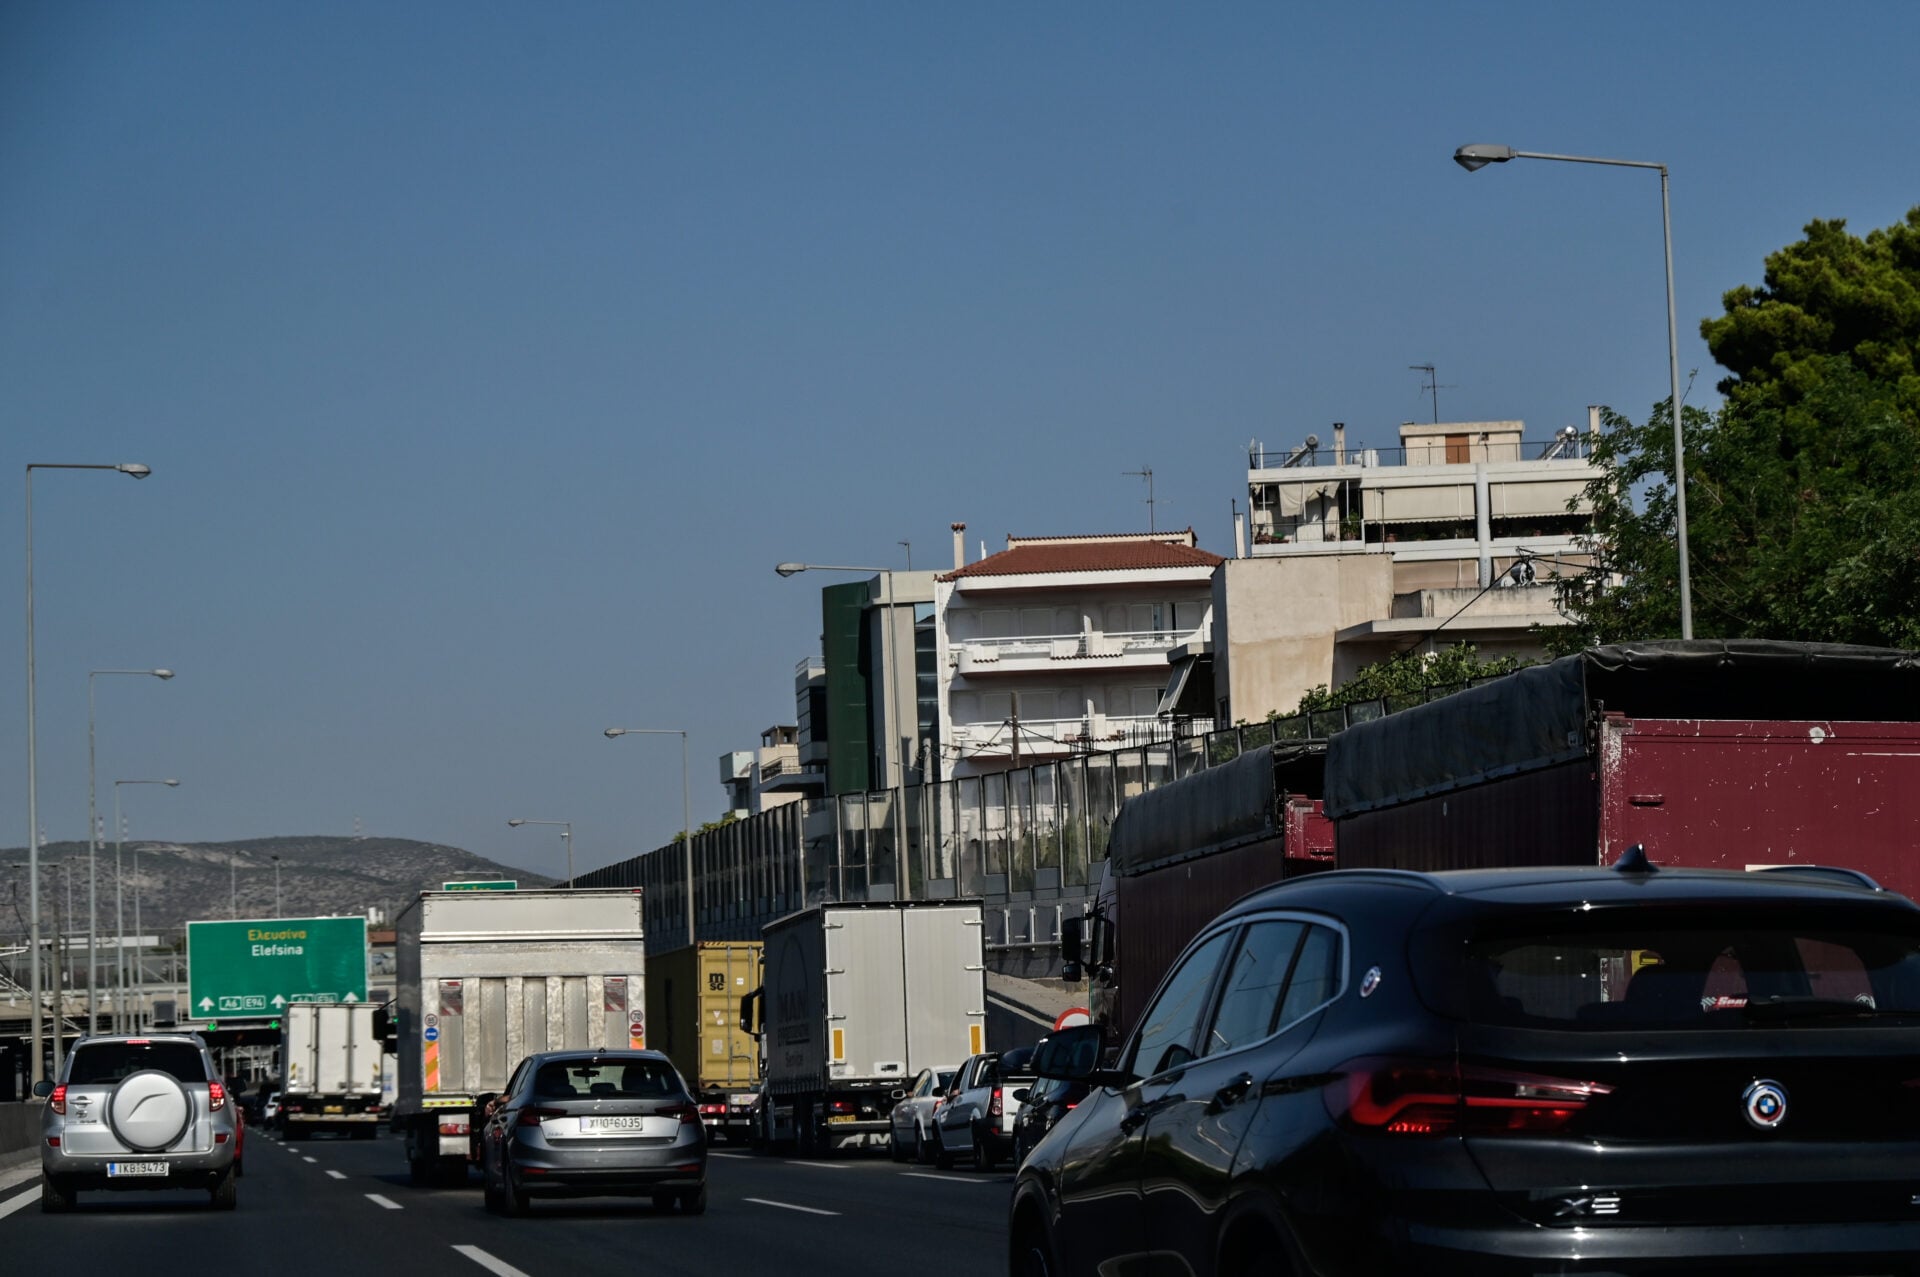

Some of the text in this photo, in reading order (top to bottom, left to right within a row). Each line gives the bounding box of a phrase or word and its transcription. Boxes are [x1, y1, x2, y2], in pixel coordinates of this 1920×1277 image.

[247, 928, 307, 941] Ελευσίνα
[251, 944, 304, 957] Elefsina
[224, 998, 263, 1008] A6 E94
